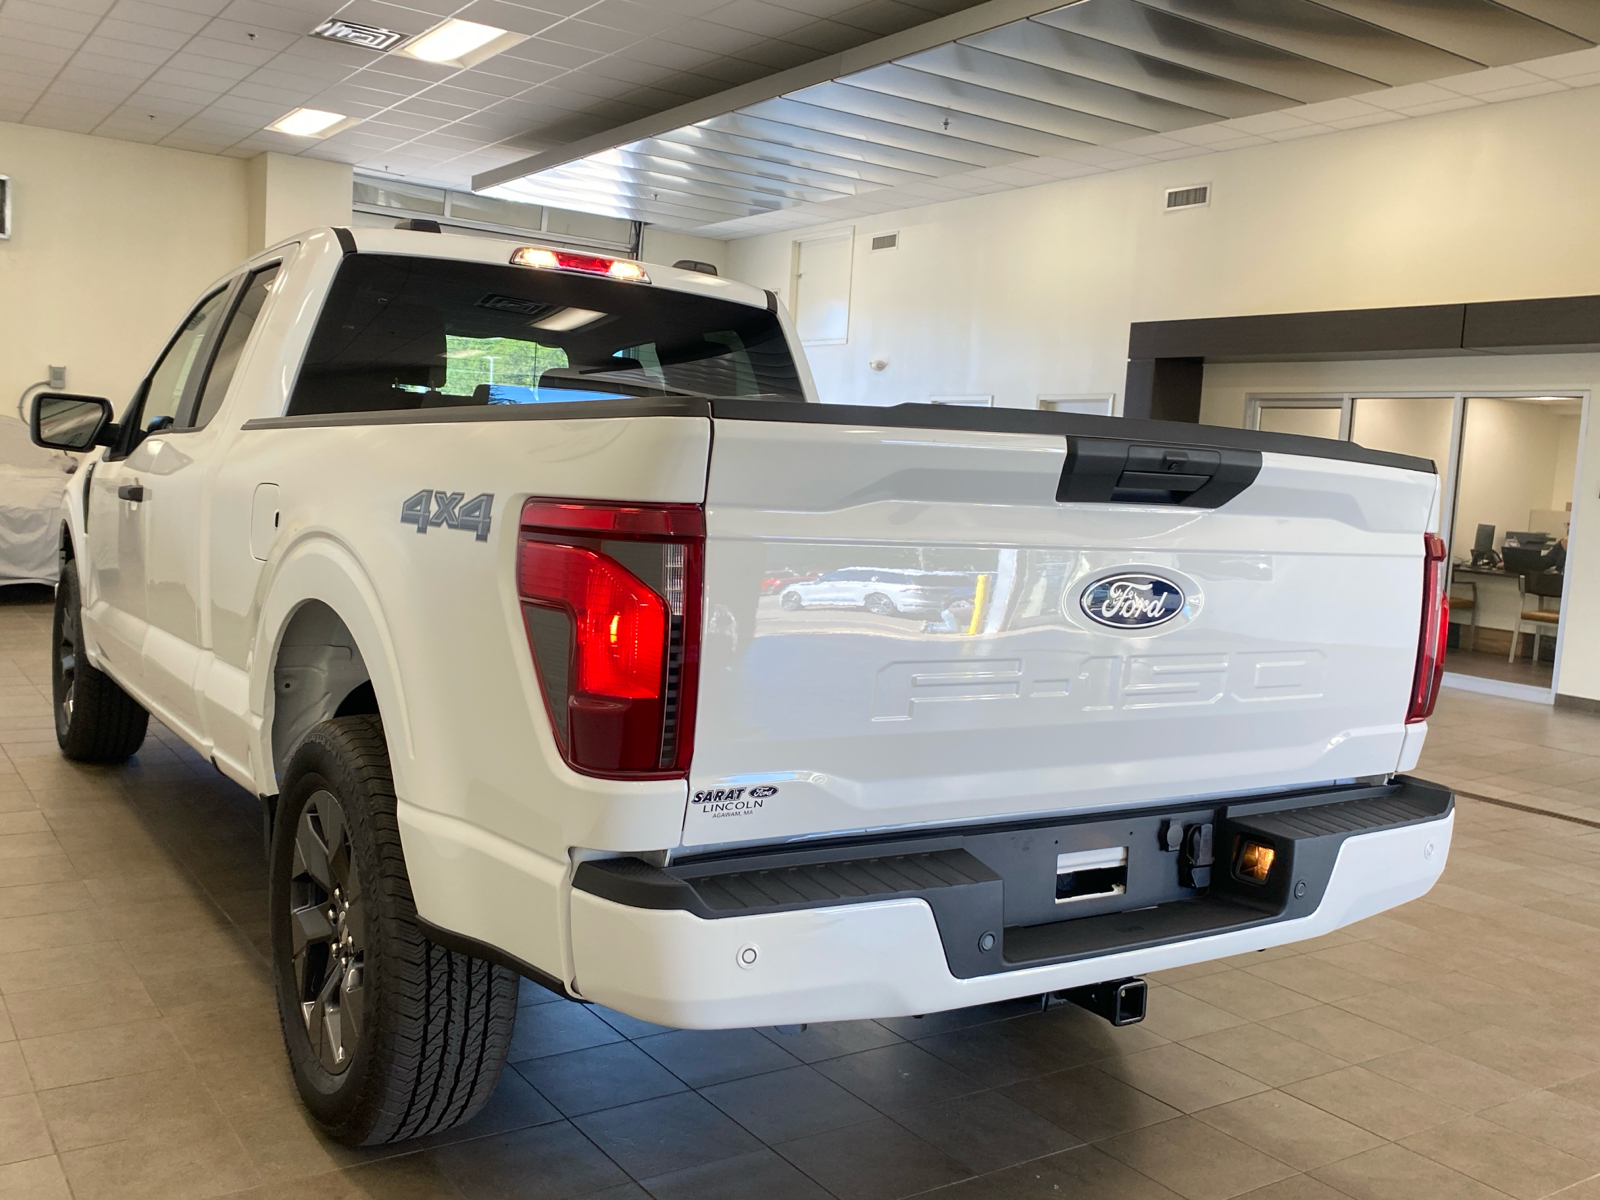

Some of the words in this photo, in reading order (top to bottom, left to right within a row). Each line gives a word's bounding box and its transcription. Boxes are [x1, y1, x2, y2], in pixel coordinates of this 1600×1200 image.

[1101, 581, 1168, 618] Ford
[871, 649, 1327, 723] F-150
[691, 787, 747, 804] SARAT
[702, 800, 763, 813] LINCOLN
